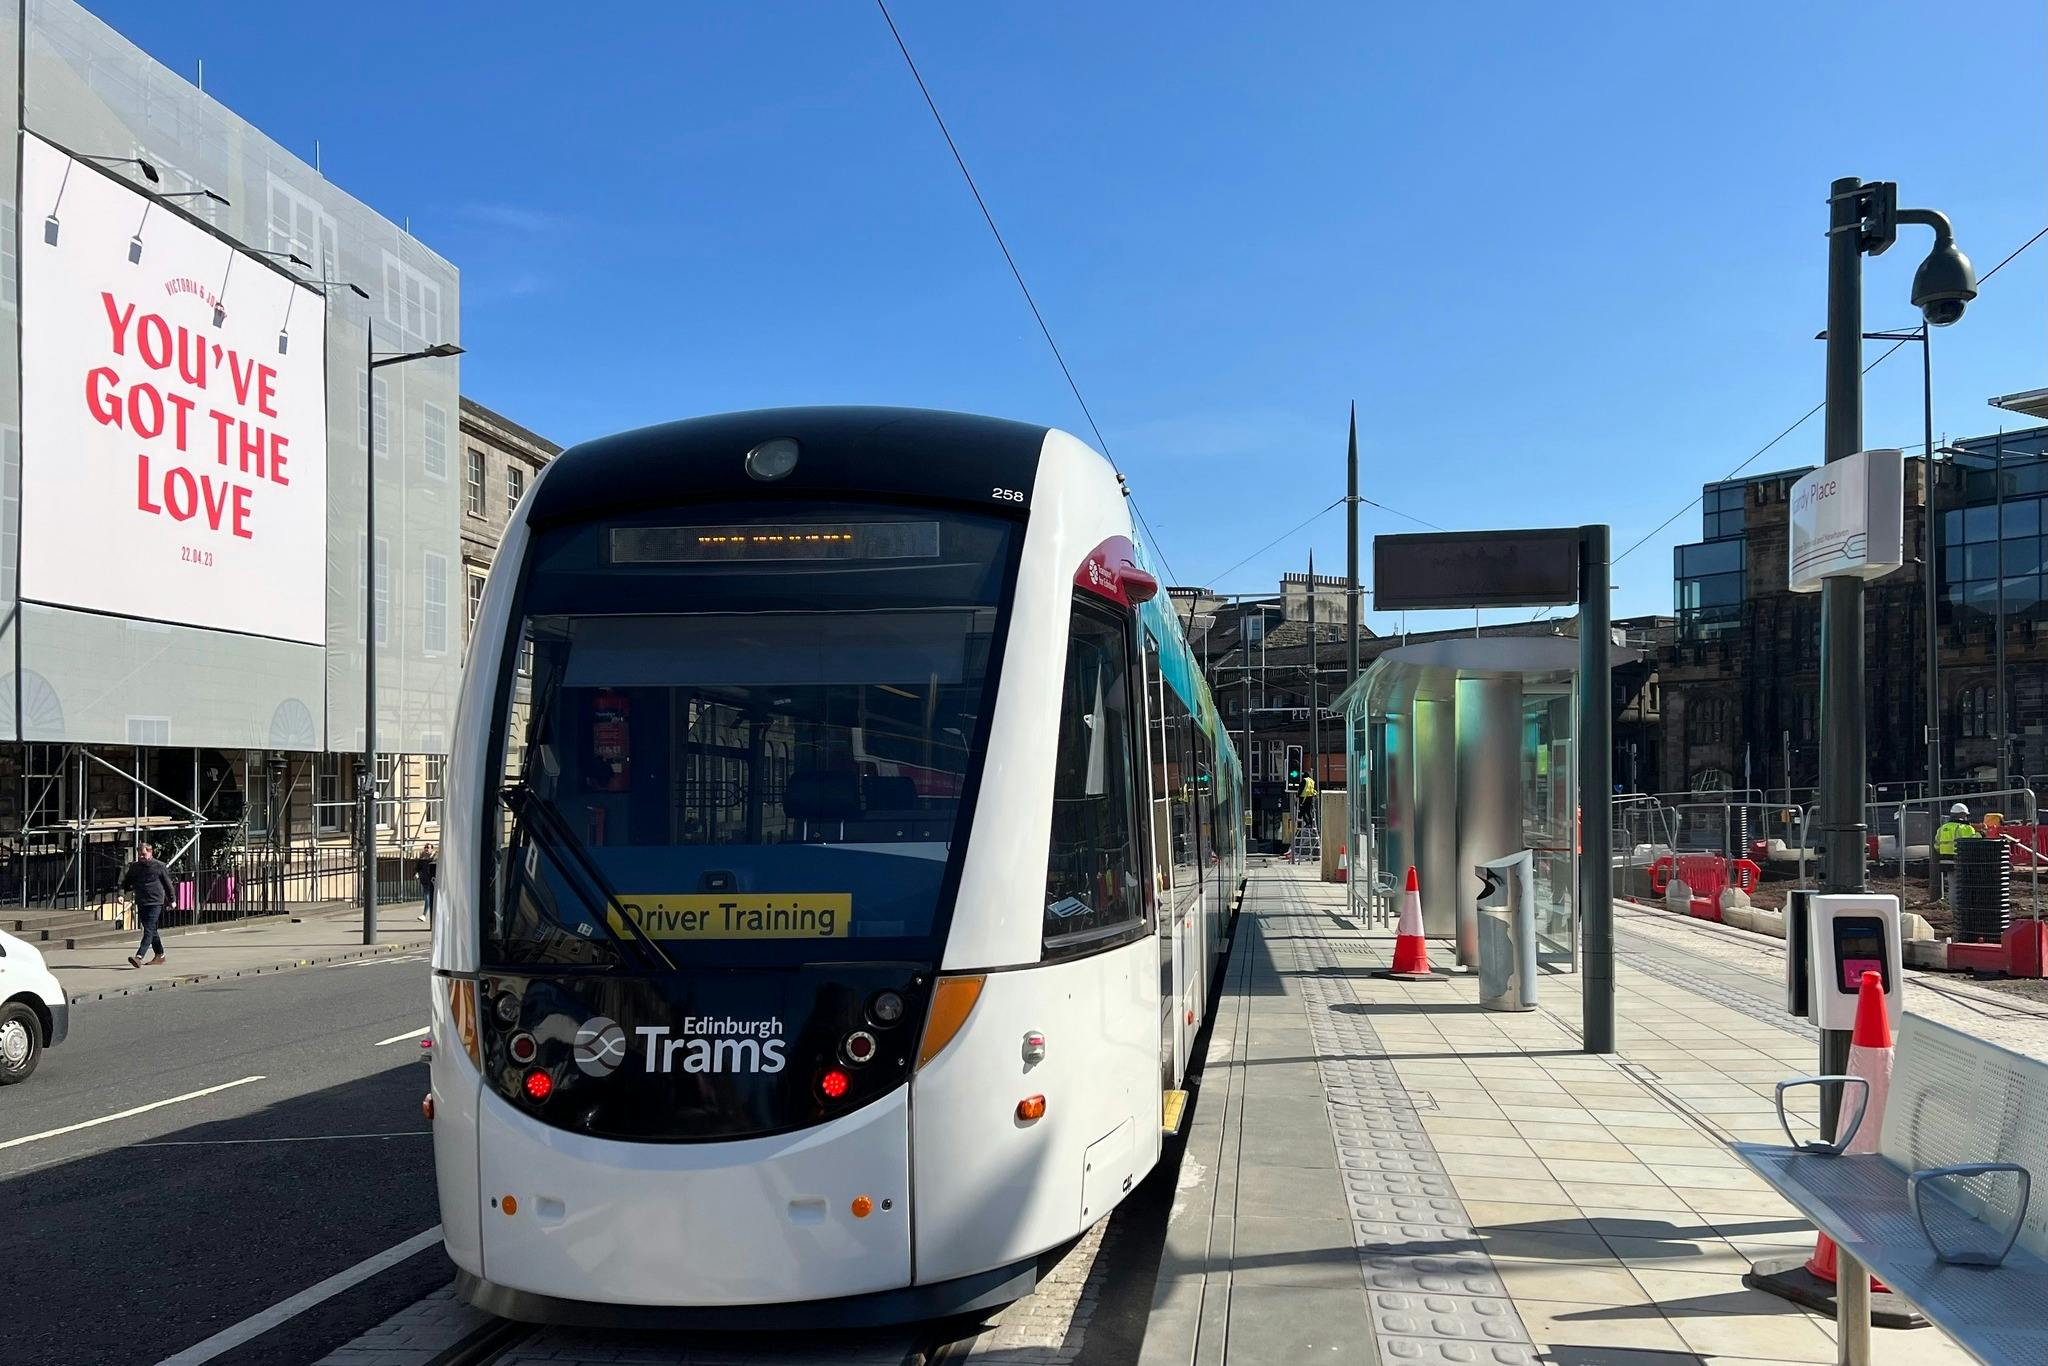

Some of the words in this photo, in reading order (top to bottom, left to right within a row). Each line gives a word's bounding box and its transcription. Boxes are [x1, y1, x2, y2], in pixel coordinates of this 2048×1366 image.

[164, 278, 198, 297] VICTORIA
[102, 292, 278, 418] YOU'VE
[86, 367, 196, 452] GOT
[210, 410, 290, 486] THE
[138, 455, 254, 540] LOVE
[992, 487, 1024, 502] 258
[1810, 480, 1837, 504] Place
[181, 546, 213, 567] 22.04.23
[621, 903, 710, 931] Driver
[718, 903, 835, 936] Training
[684, 1016, 783, 1038] Edinburgh
[635, 1026, 786, 1073] Trams
